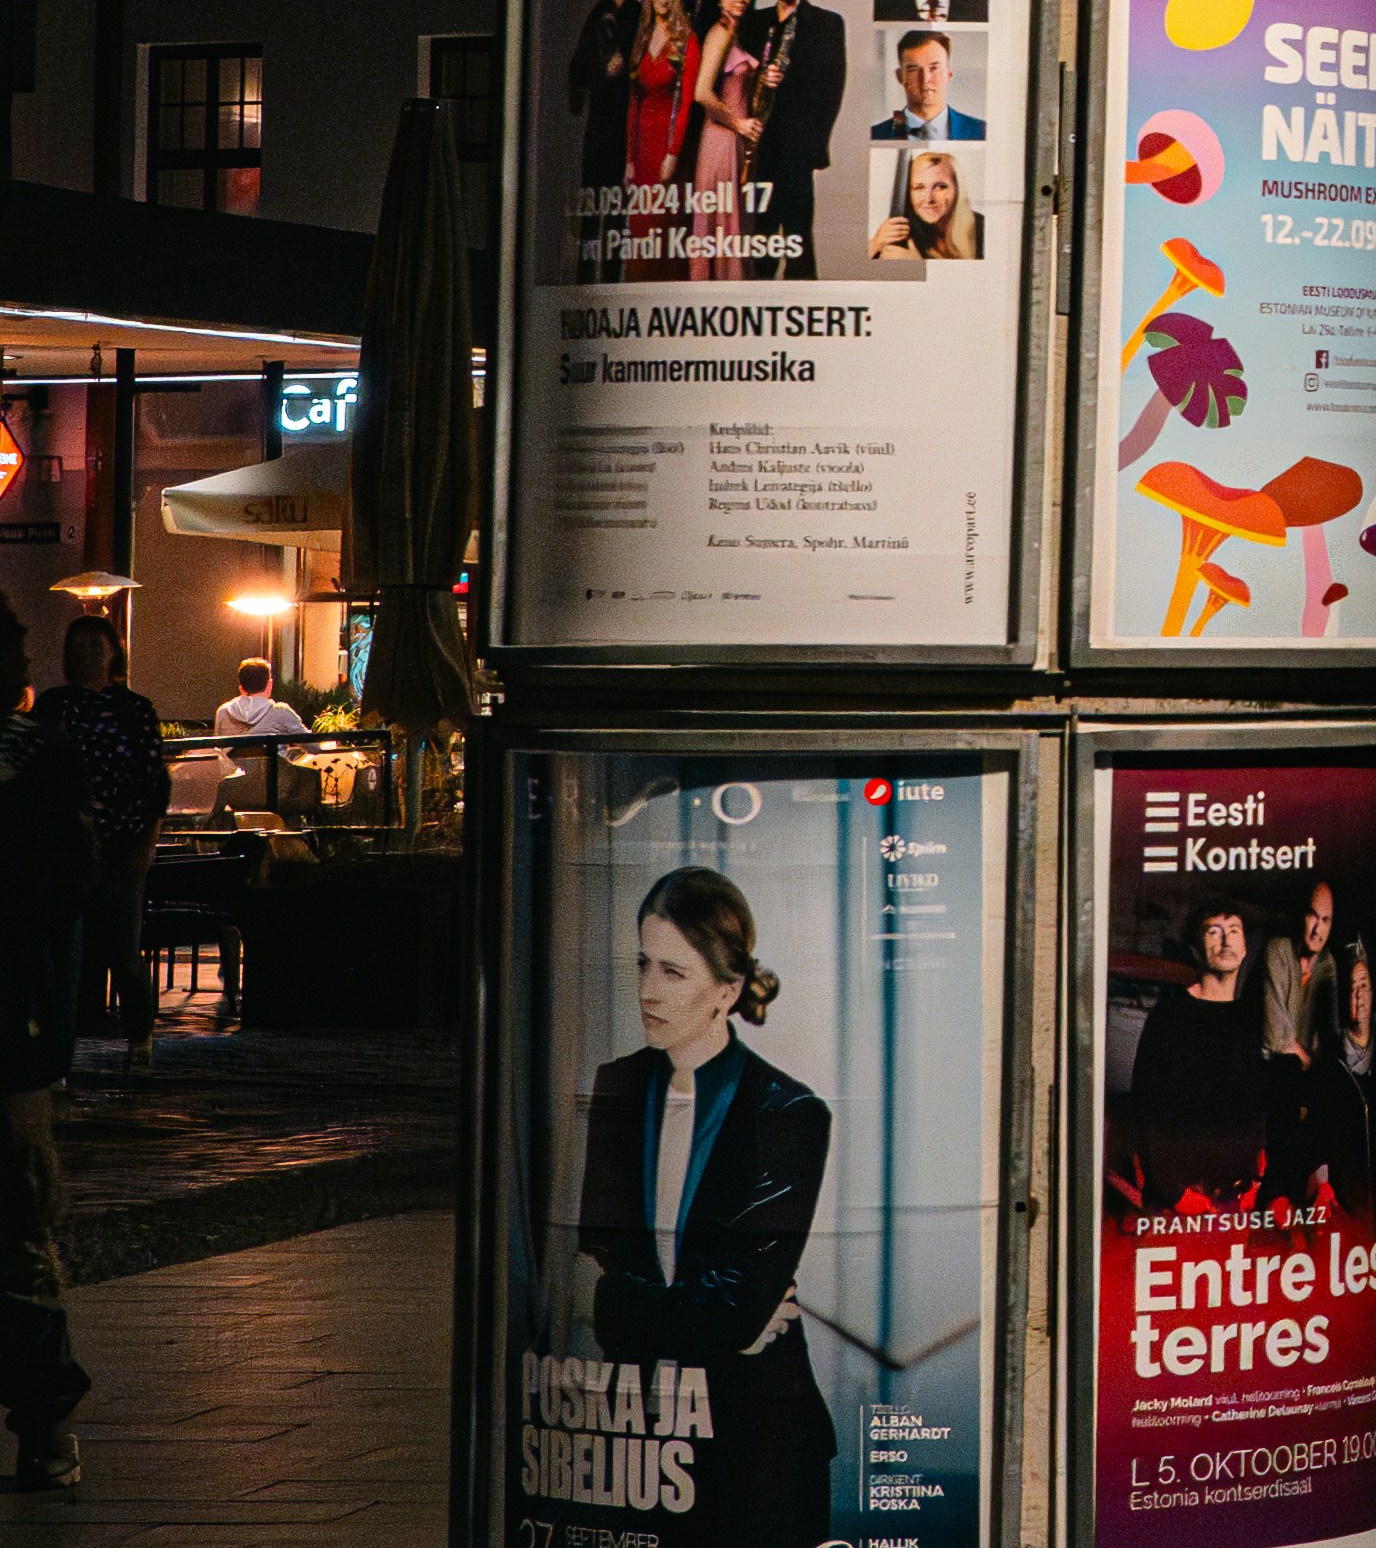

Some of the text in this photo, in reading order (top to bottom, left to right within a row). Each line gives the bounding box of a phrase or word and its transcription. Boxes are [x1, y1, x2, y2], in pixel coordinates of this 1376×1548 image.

[684, 181, 734, 214] kell
[741, 181, 774, 214] 17
[1261, 179, 1362, 204] MUSHROOM
[606, 227, 663, 260] Pärdi
[667, 225, 804, 259] Keskuses
[646, 305, 872, 338] AVAKONTSERT:
[602, 350, 816, 383] kammermuusika
[898, 780, 945, 801] iute
[1186, 790, 1266, 828] Eesti
[1185, 836, 1317, 872] Kontsert
[1136, 1205, 1327, 1236] PRANTSUSE JAZZ
[1135, 1243, 1316, 1313] Entre
[1130, 1314, 1330, 1379] terres
[522, 1352, 714, 1439] POSKA JA
[869, 1427, 952, 1441] GERHARDT
[870, 1415, 924, 1427] ALBAN
[521, 1424, 696, 1514] SIBELIUS
[869, 1450, 908, 1463] ERSO
[1131, 1457, 1150, 1487] L
[1158, 1455, 1182, 1485] 5.
[1190, 1438, 1338, 1482] OKTOOBER
[869, 1484, 945, 1498] KRISTIINA
[869, 1498, 921, 1511] POSKA
[1130, 1476, 1313, 1511] Estonia kontserdisaal
